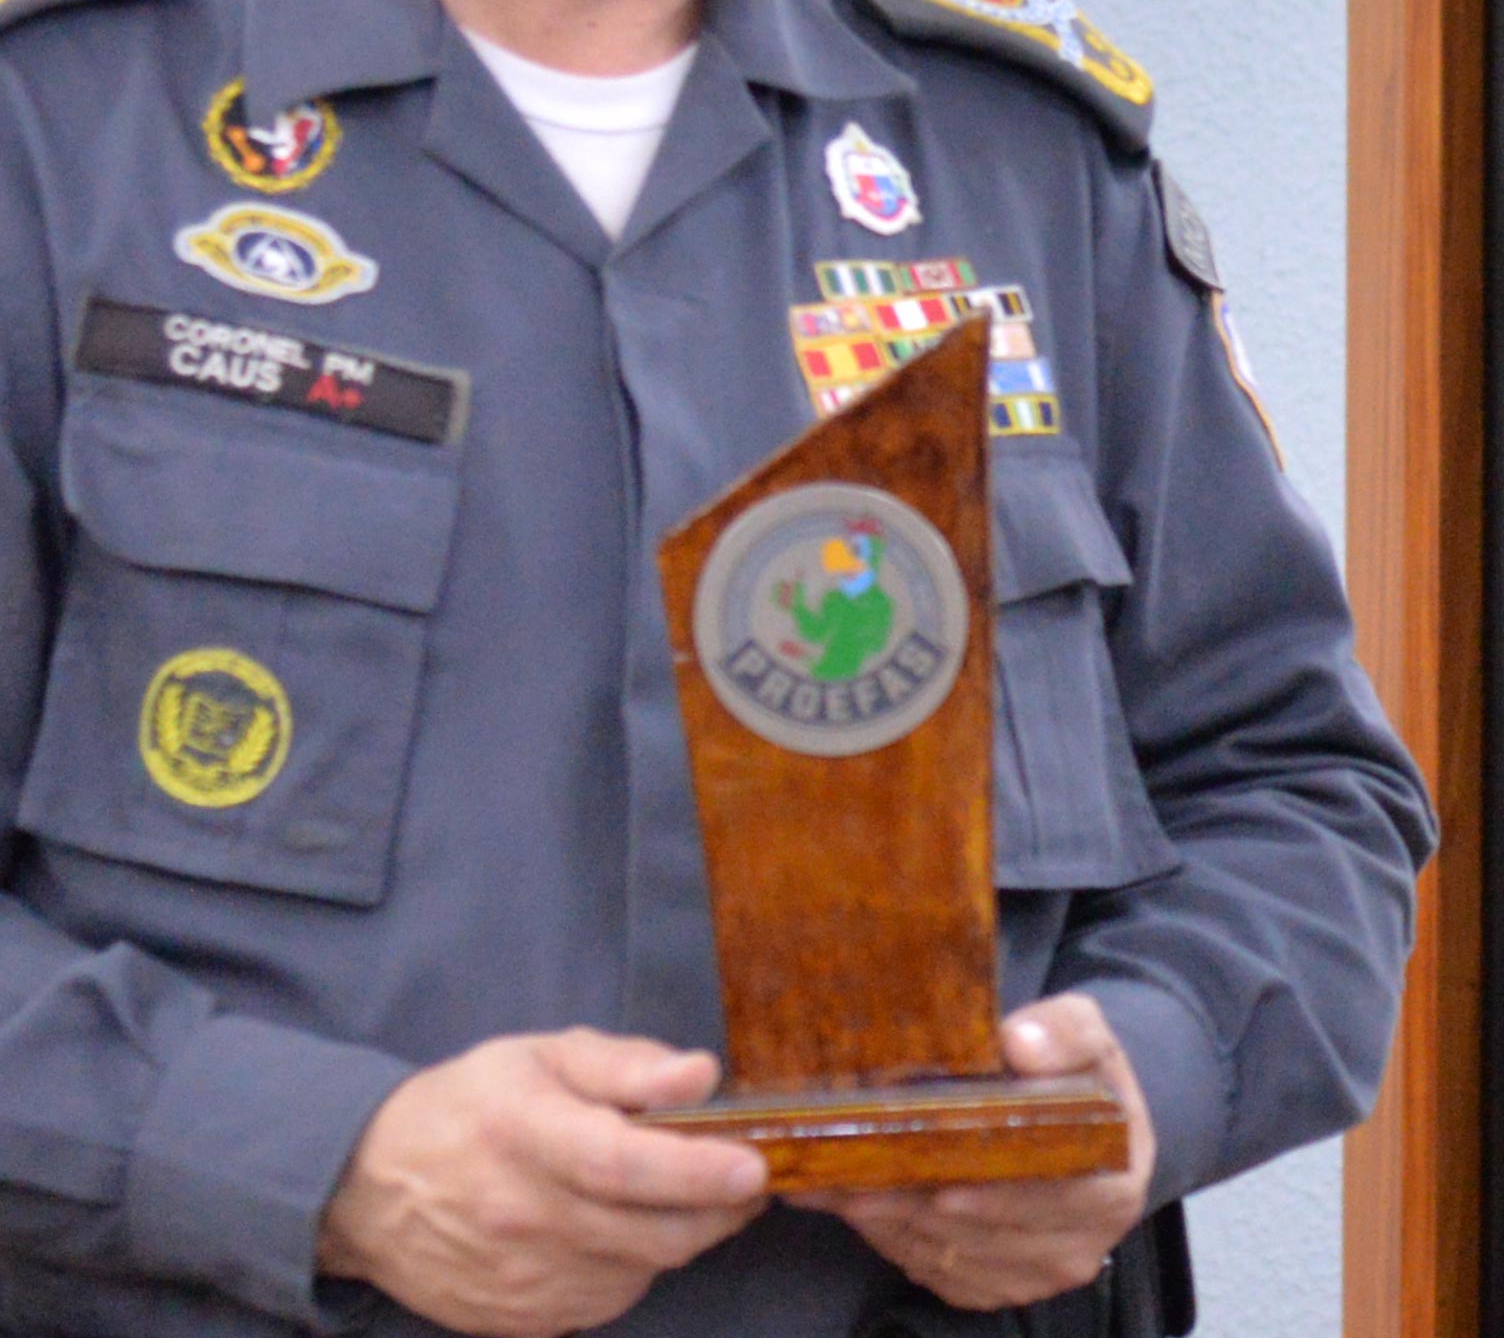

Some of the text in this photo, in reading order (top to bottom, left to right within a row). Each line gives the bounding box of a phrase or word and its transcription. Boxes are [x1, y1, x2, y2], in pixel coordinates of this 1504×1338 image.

[163, 313, 375, 386] CORONEL PM
[169, 343, 283, 393] CAUS
